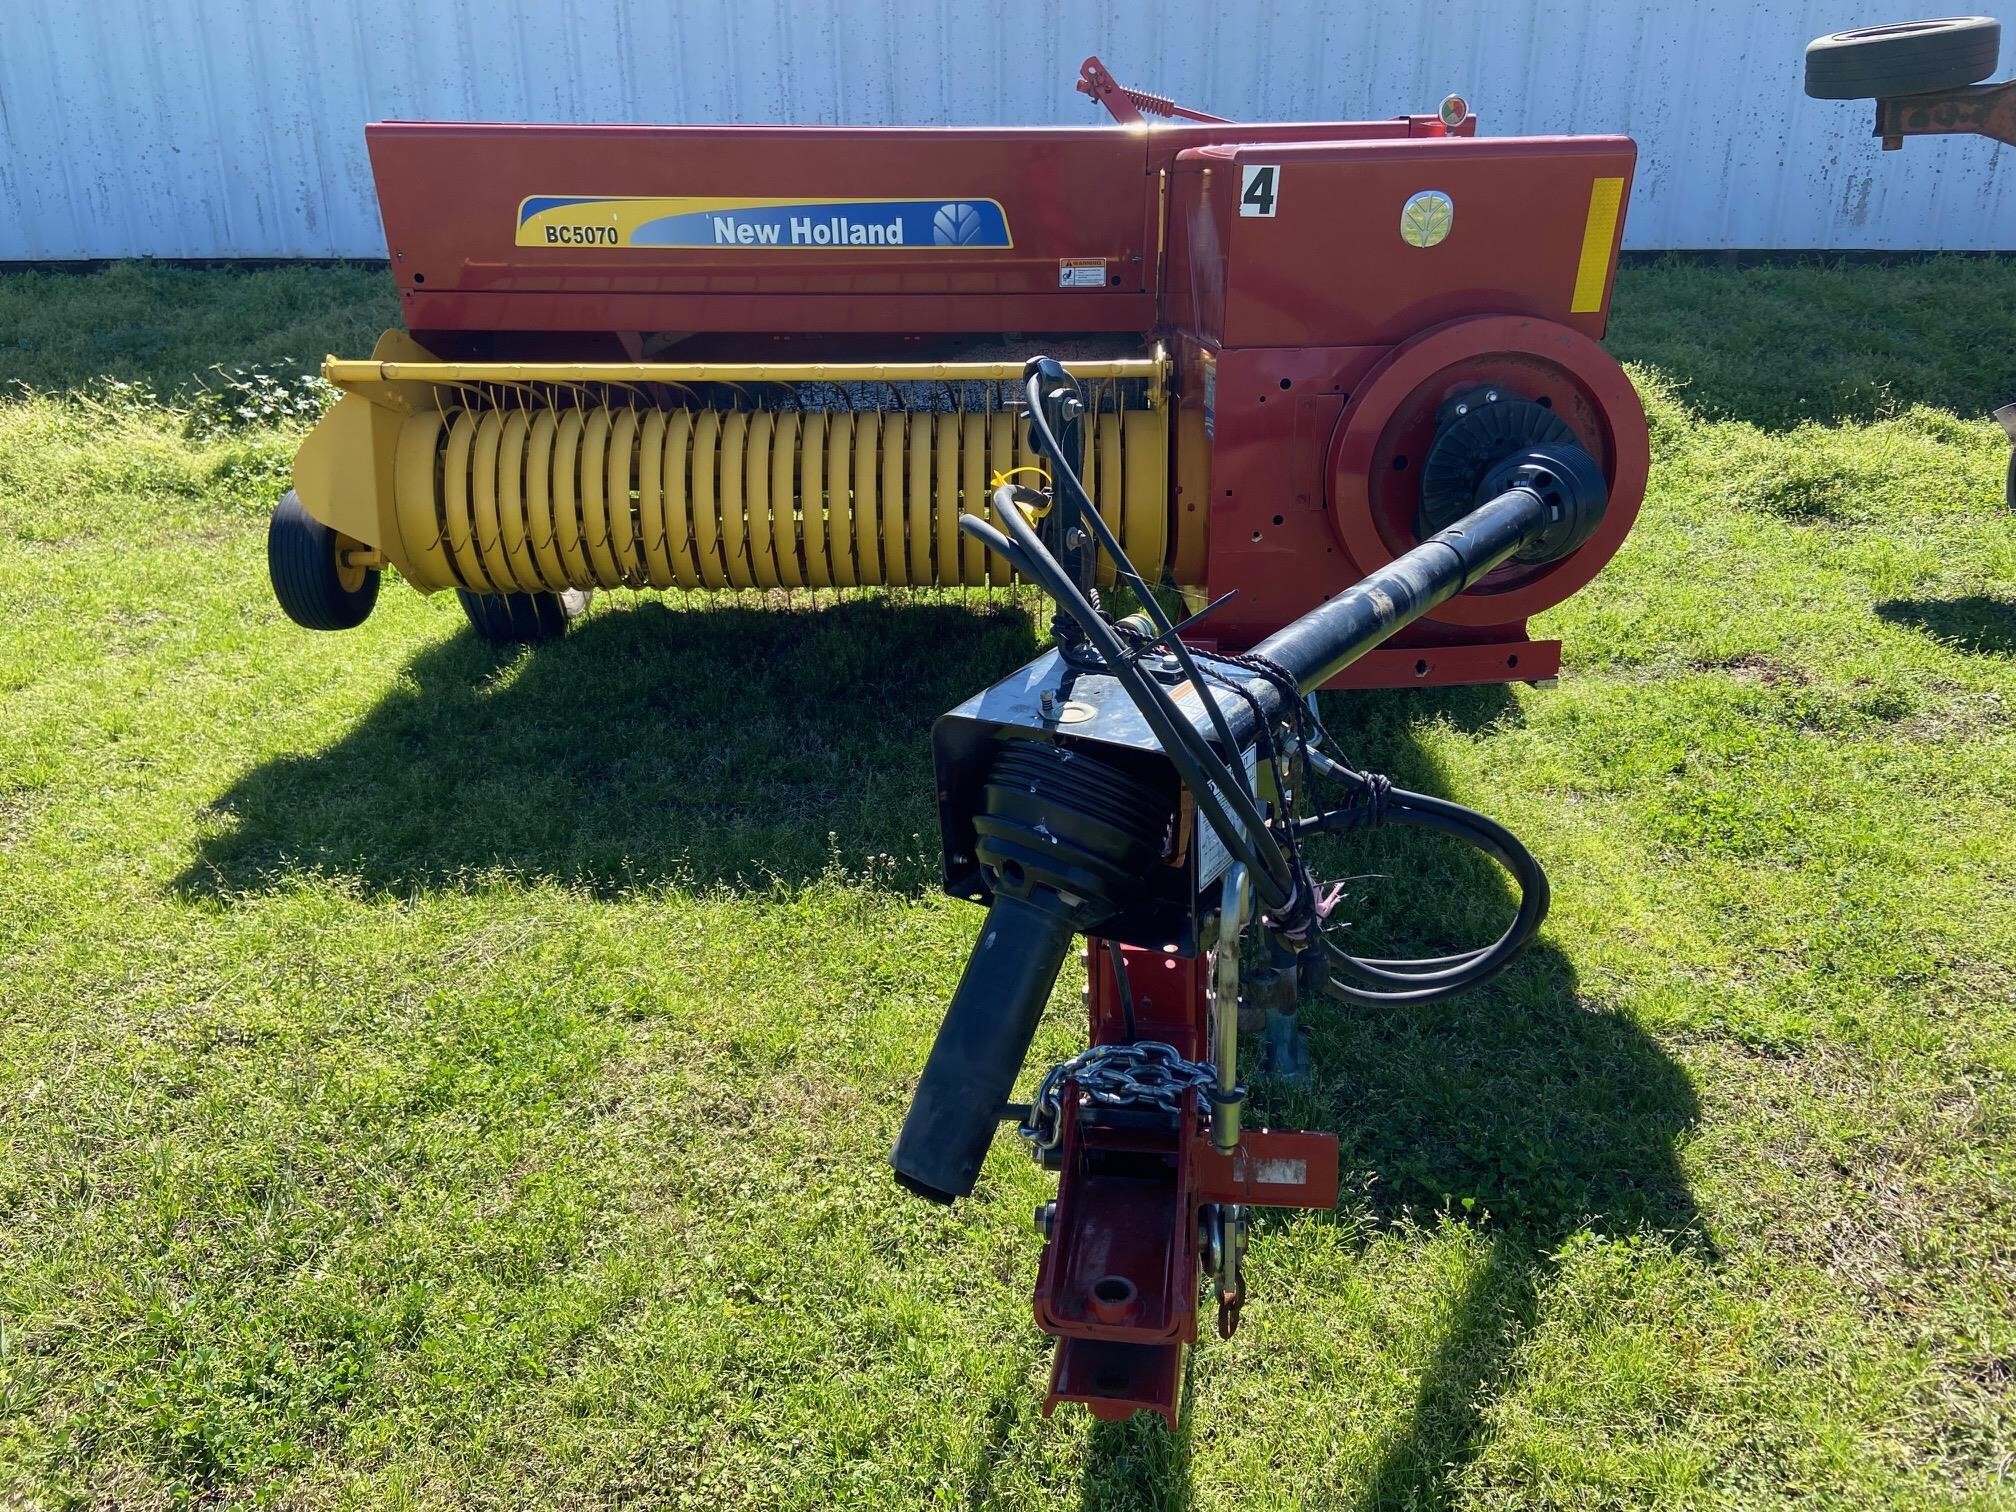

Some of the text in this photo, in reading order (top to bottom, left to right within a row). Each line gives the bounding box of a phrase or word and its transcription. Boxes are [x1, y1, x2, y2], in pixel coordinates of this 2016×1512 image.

[1243, 167, 1274, 215] 4
[545, 225, 619, 244] BC5070
[713, 217, 904, 245] New Holland
